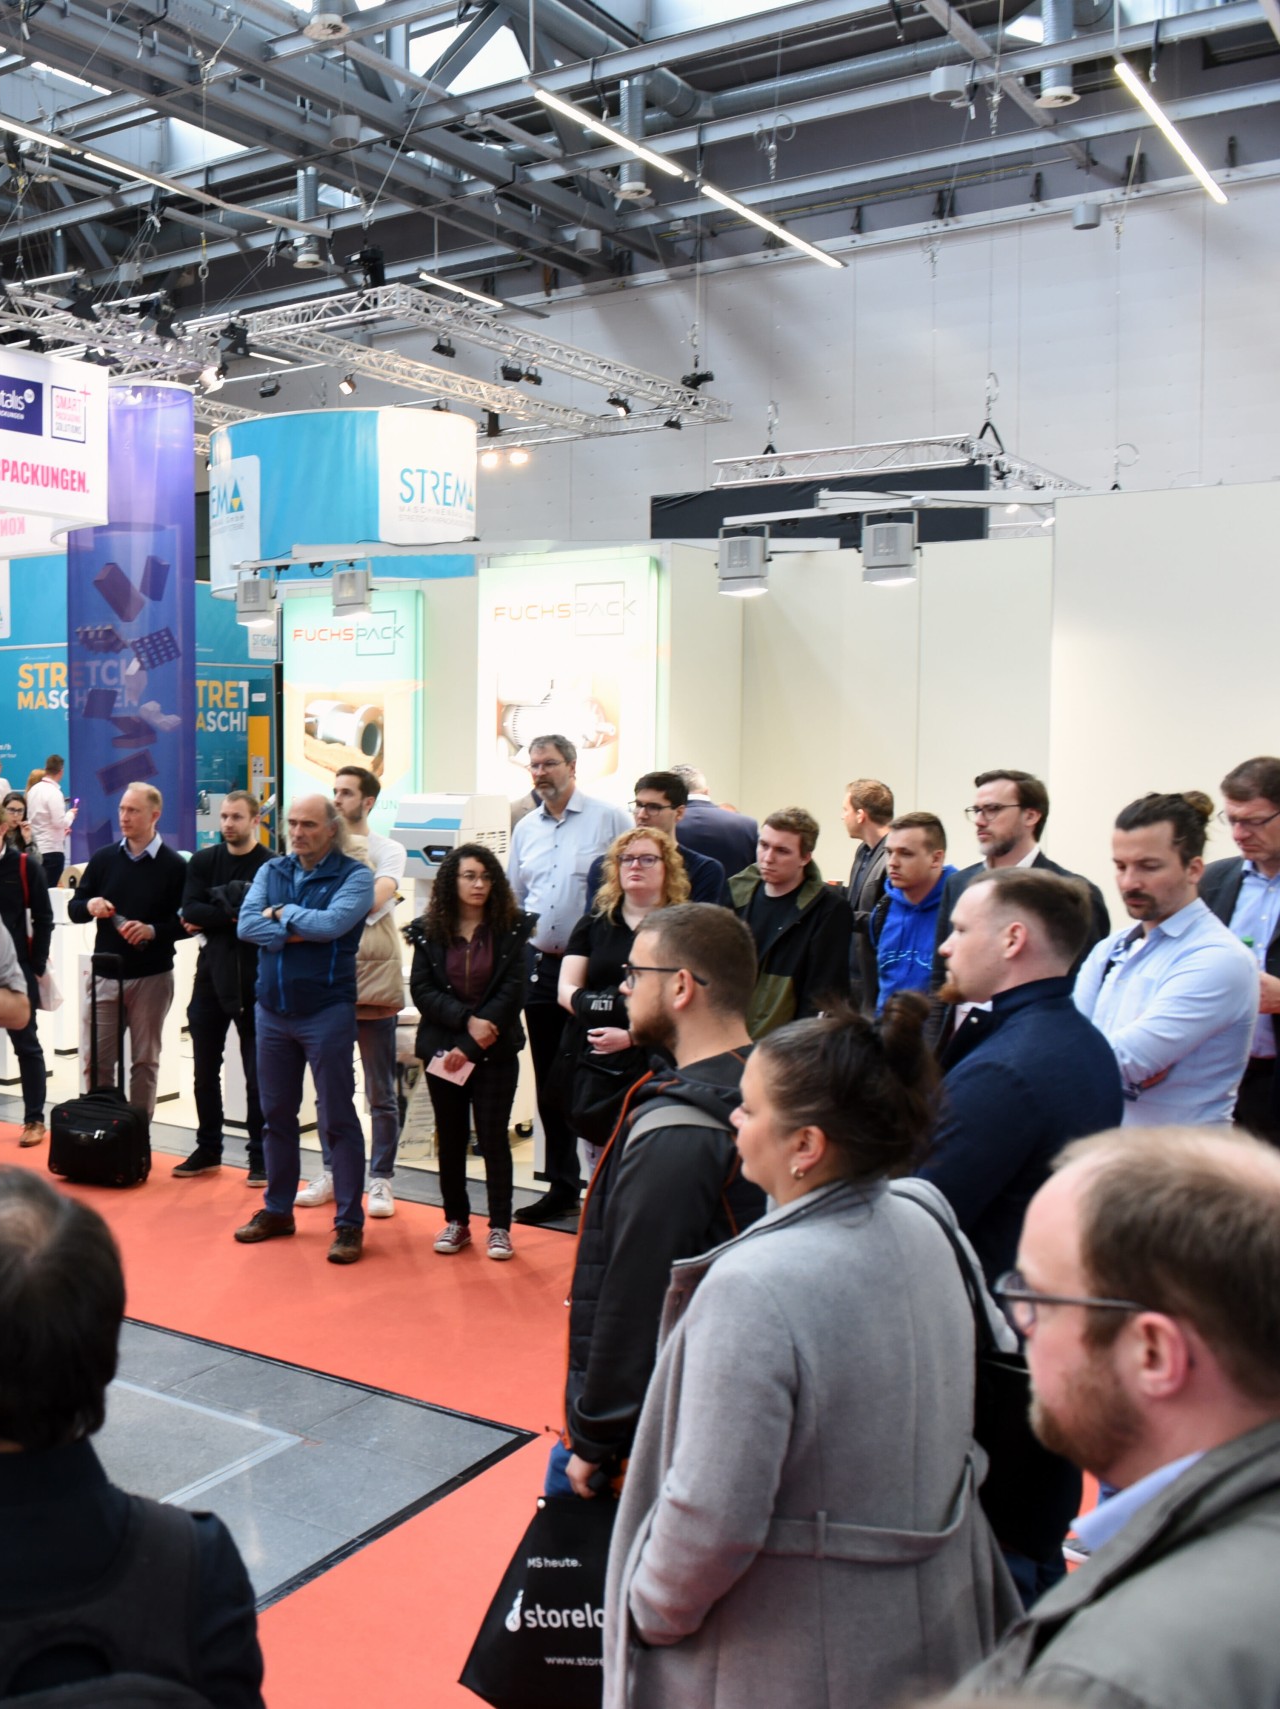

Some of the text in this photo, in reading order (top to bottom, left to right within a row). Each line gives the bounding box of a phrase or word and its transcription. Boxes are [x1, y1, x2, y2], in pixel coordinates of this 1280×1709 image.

[293, 625, 406, 641] FUCHSPACK
[527, 1557, 582, 1568] MS heute.
